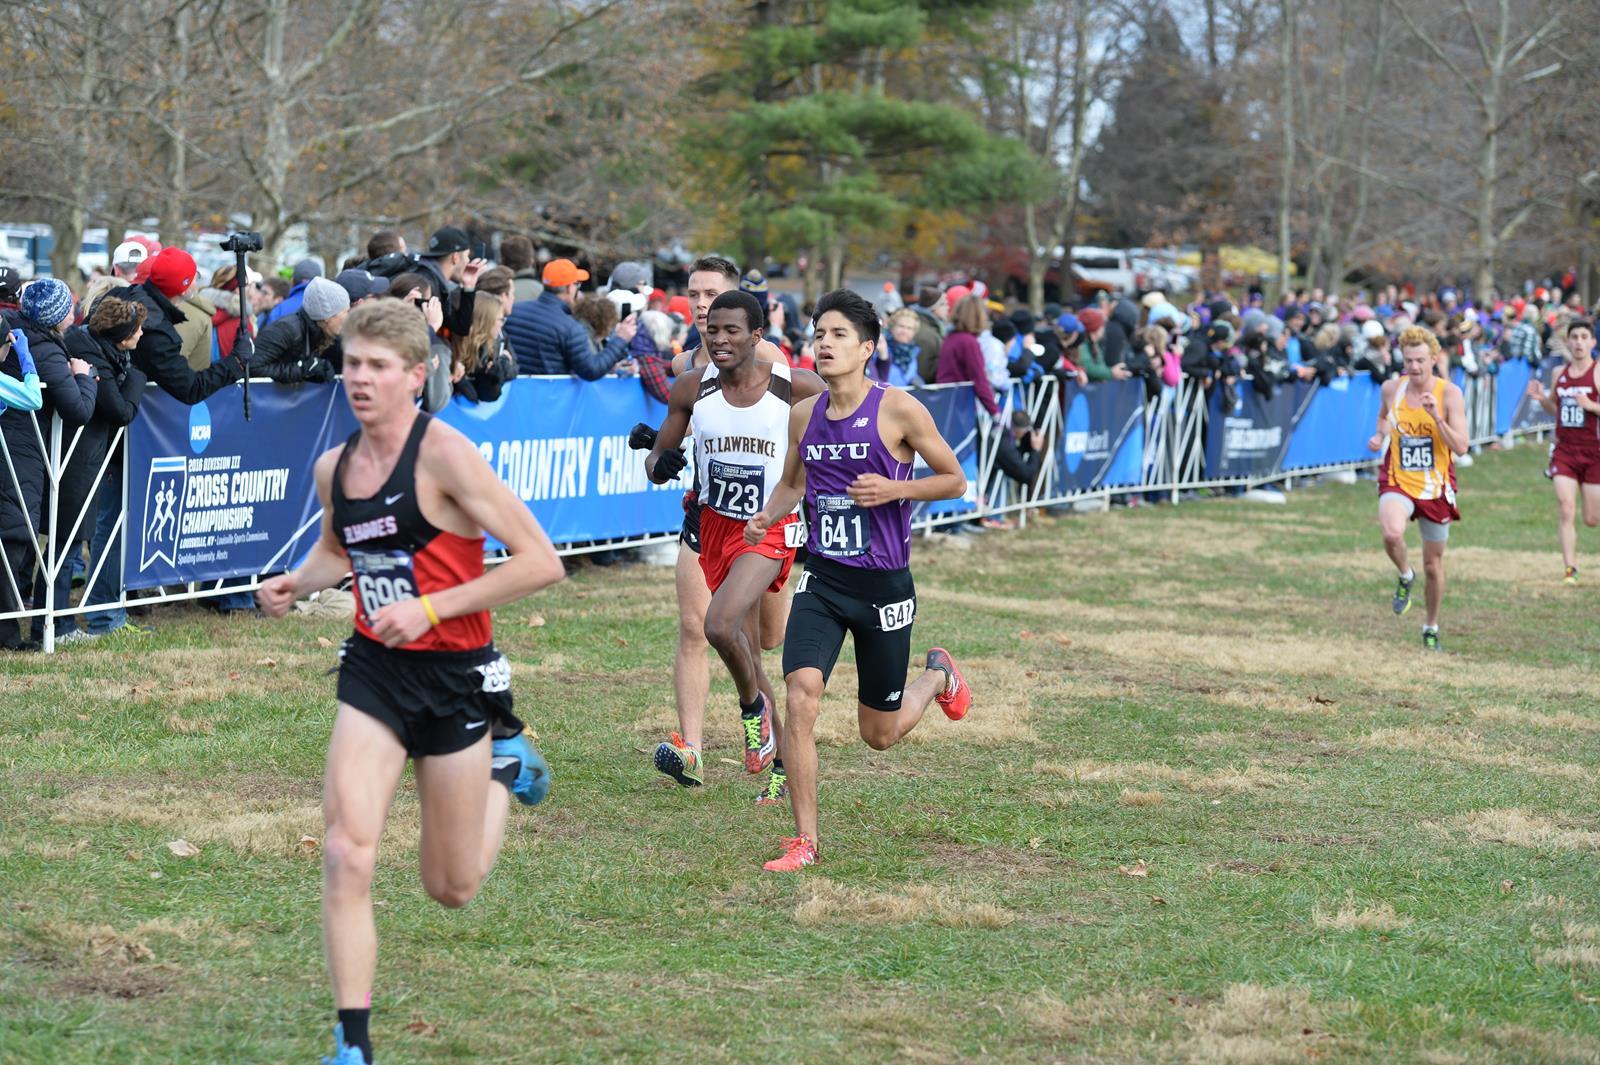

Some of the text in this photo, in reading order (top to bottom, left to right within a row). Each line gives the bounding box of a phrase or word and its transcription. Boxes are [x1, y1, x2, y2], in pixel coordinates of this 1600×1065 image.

[1561, 405, 1584, 424] 616
[190, 425, 211, 441] NCAA
[1397, 423, 1433, 435] CMS
[704, 436, 776, 458] ST. LAWRENCE
[806, 442, 870, 461] NYU
[1401, 447, 1432, 468] 545
[188, 455, 241, 472] 2016 DIVISION III
[497, 437, 594, 502] COUNTRY
[185, 468, 289, 509] CROSS COUNTRY
[713, 478, 760, 514] 723
[182, 506, 254, 535] CHAMPIONSHIPS
[821, 514, 863, 549] 641
[883, 602, 911, 628] 641
